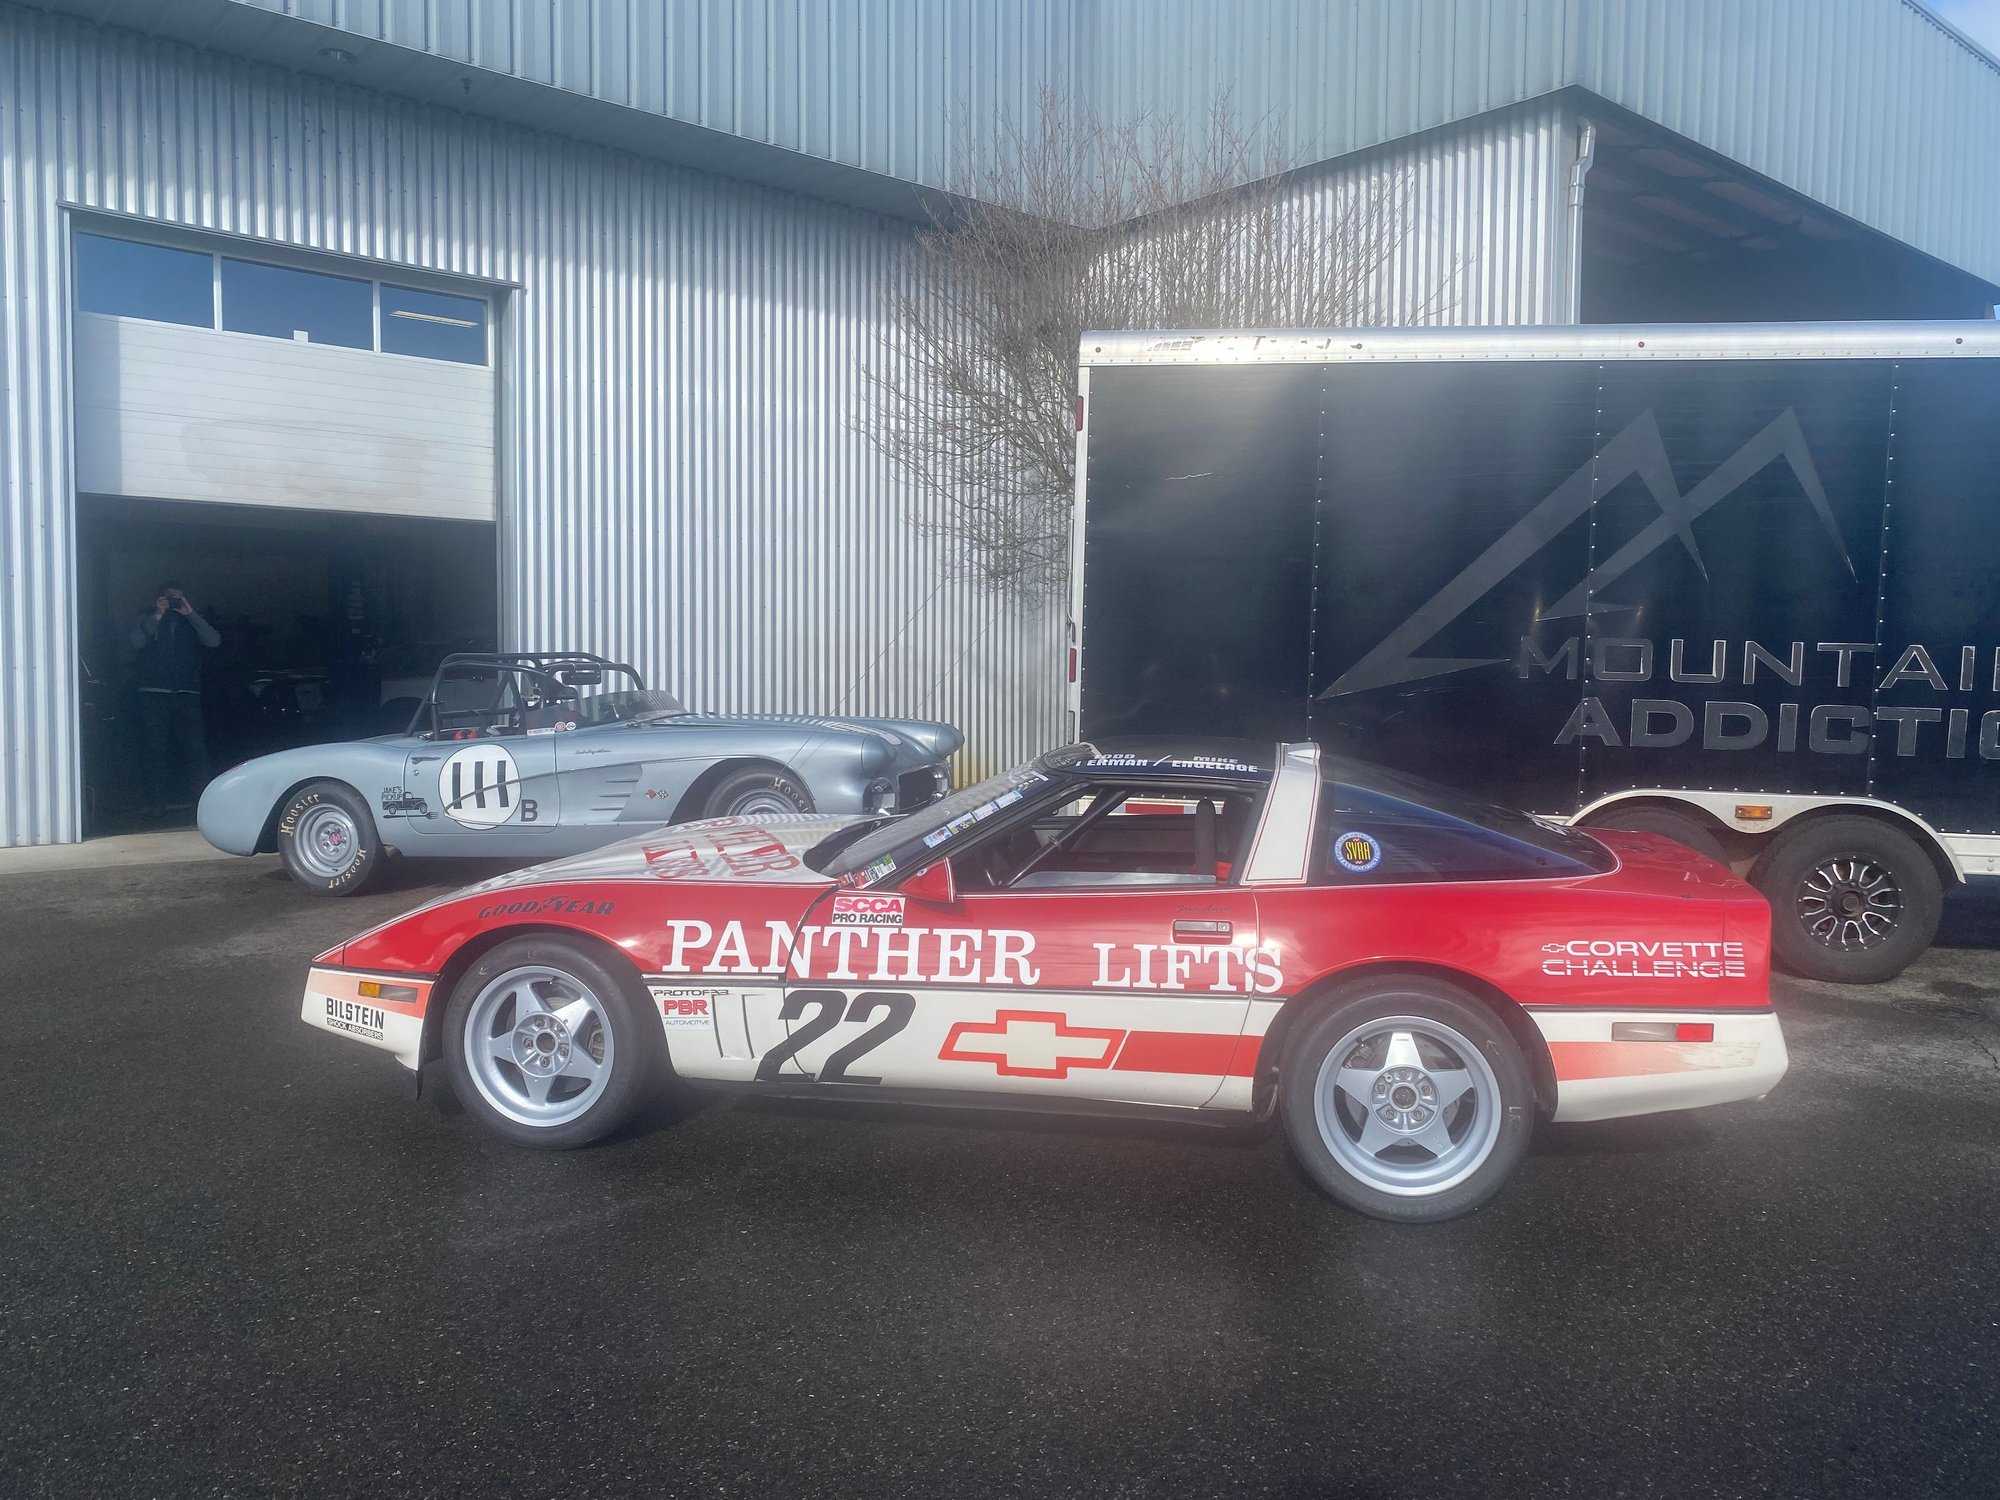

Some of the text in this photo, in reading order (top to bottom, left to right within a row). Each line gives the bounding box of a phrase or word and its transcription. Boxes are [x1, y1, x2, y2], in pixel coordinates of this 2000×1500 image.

[1519, 636, 2000, 692] MOUNTAI
[1193, 756, 1239, 764] MIKE
[451, 760, 510, 810] 111
[520, 799, 539, 822] B
[1345, 841, 1371, 861] SVRA
[478, 898, 616, 920] GOODYEAR
[834, 897, 903, 914] SCCA
[832, 913, 903, 924] PRO RACING
[662, 919, 1285, 994] PANTHER LIFTS
[1566, 940, 1745, 958] CORVETTE
[1541, 959, 1746, 978] CHALLENGE
[326, 997, 385, 1030] BILSTEIN
[663, 999, 709, 1016] PBR
[327, 1018, 383, 1040] SHOCK ABSORBERS
[753, 989, 917, 1086] 22
